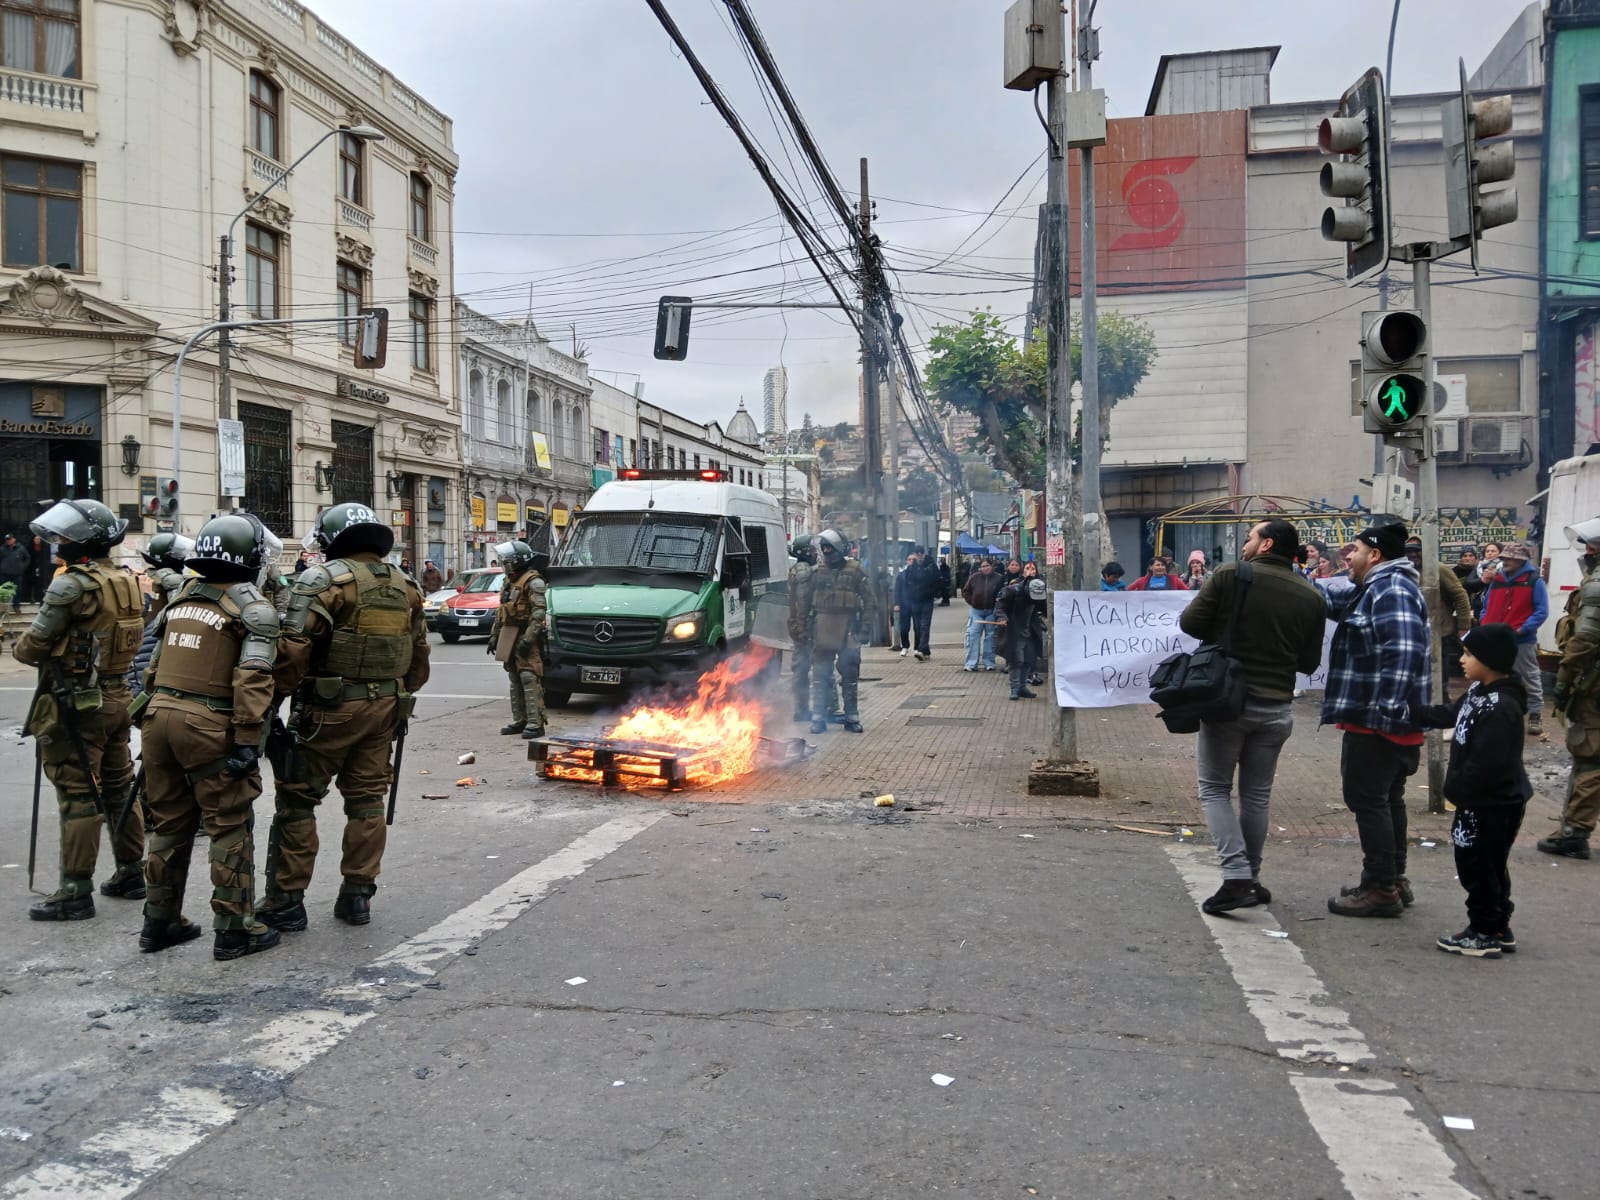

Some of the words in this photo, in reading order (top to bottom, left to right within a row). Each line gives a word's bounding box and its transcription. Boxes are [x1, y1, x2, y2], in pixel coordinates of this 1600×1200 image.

[0, 419, 93, 436] BancoEstado
[346, 508, 377, 522] C.O.P.
[1443, 527, 1473, 536] KING
[1480, 535, 1514, 543] ALPHA
[1482, 527, 1512, 536] KING
[197, 536, 223, 552] C.O.P.
[168, 631, 178, 646] DE
[179, 633, 202, 649] CHILE
[1083, 634, 1184, 659] LADRONA
